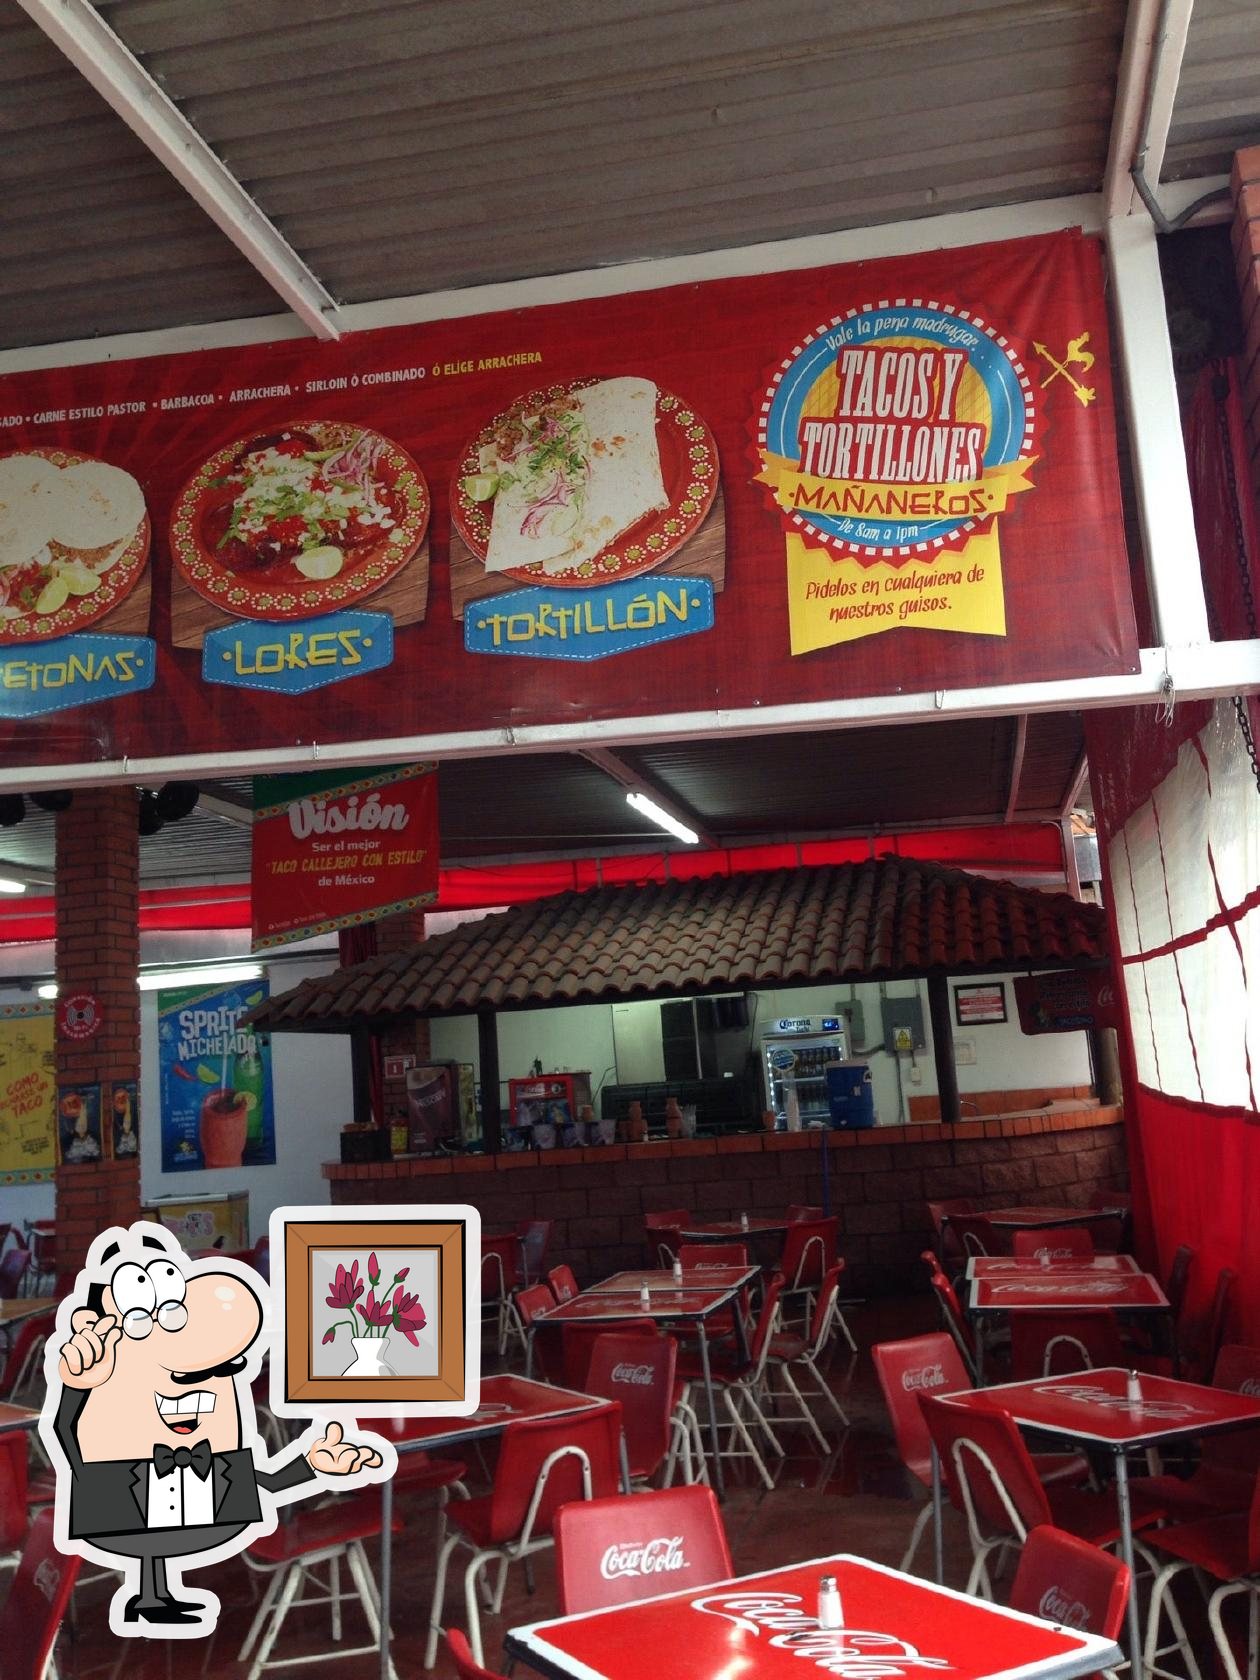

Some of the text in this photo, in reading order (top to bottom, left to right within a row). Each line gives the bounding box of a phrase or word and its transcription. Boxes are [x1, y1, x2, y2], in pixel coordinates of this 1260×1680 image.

[826, 327, 853, 351] Vale
[857, 318, 871, 336] la
[874, 316, 910, 336] pena
[0, 415, 23, 429] ADO
[34, 409, 66, 424] CARNE
[69, 407, 104, 420] ESTILO
[107, 402, 146, 416] PASTOR
[161, 393, 215, 410] BARBACOA
[229, 384, 291, 402] ARRACHERA
[305, 377, 348, 393] SIRLOIN
[362, 367, 426, 385] COMBINADO
[477, 351, 543, 371] ARRACHERA
[839, 350, 964, 420] TACOS Y
[803, 422, 982, 484] TORTILLONES
[793, 483, 988, 515] MAÑANEROS
[838, 519, 919, 543] De 8am a 1pm
[861, 580, 880, 596] en
[884, 570, 963, 593] cualquiera
[966, 563, 985, 582] de
[486, 588, 688, 647] TORTILLÓN
[829, 596, 953, 623] nuestros guisos.
[235, 629, 362, 676] LORES
[0, 650, 136, 692] ETONAS
[288, 792, 410, 839] Visión
[302, 856, 358, 872] CALLEJERO
[362, 853, 383, 867] CON
[312, 839, 382, 853] Ser el mejor
[318, 874, 376, 887] de México
[779, 1018, 812, 1030] Corona
[6, 1071, 40, 1096] COMO
[11, 1095, 43, 1119] TACO
[599, 1535, 686, 1580] Coca-Cola
